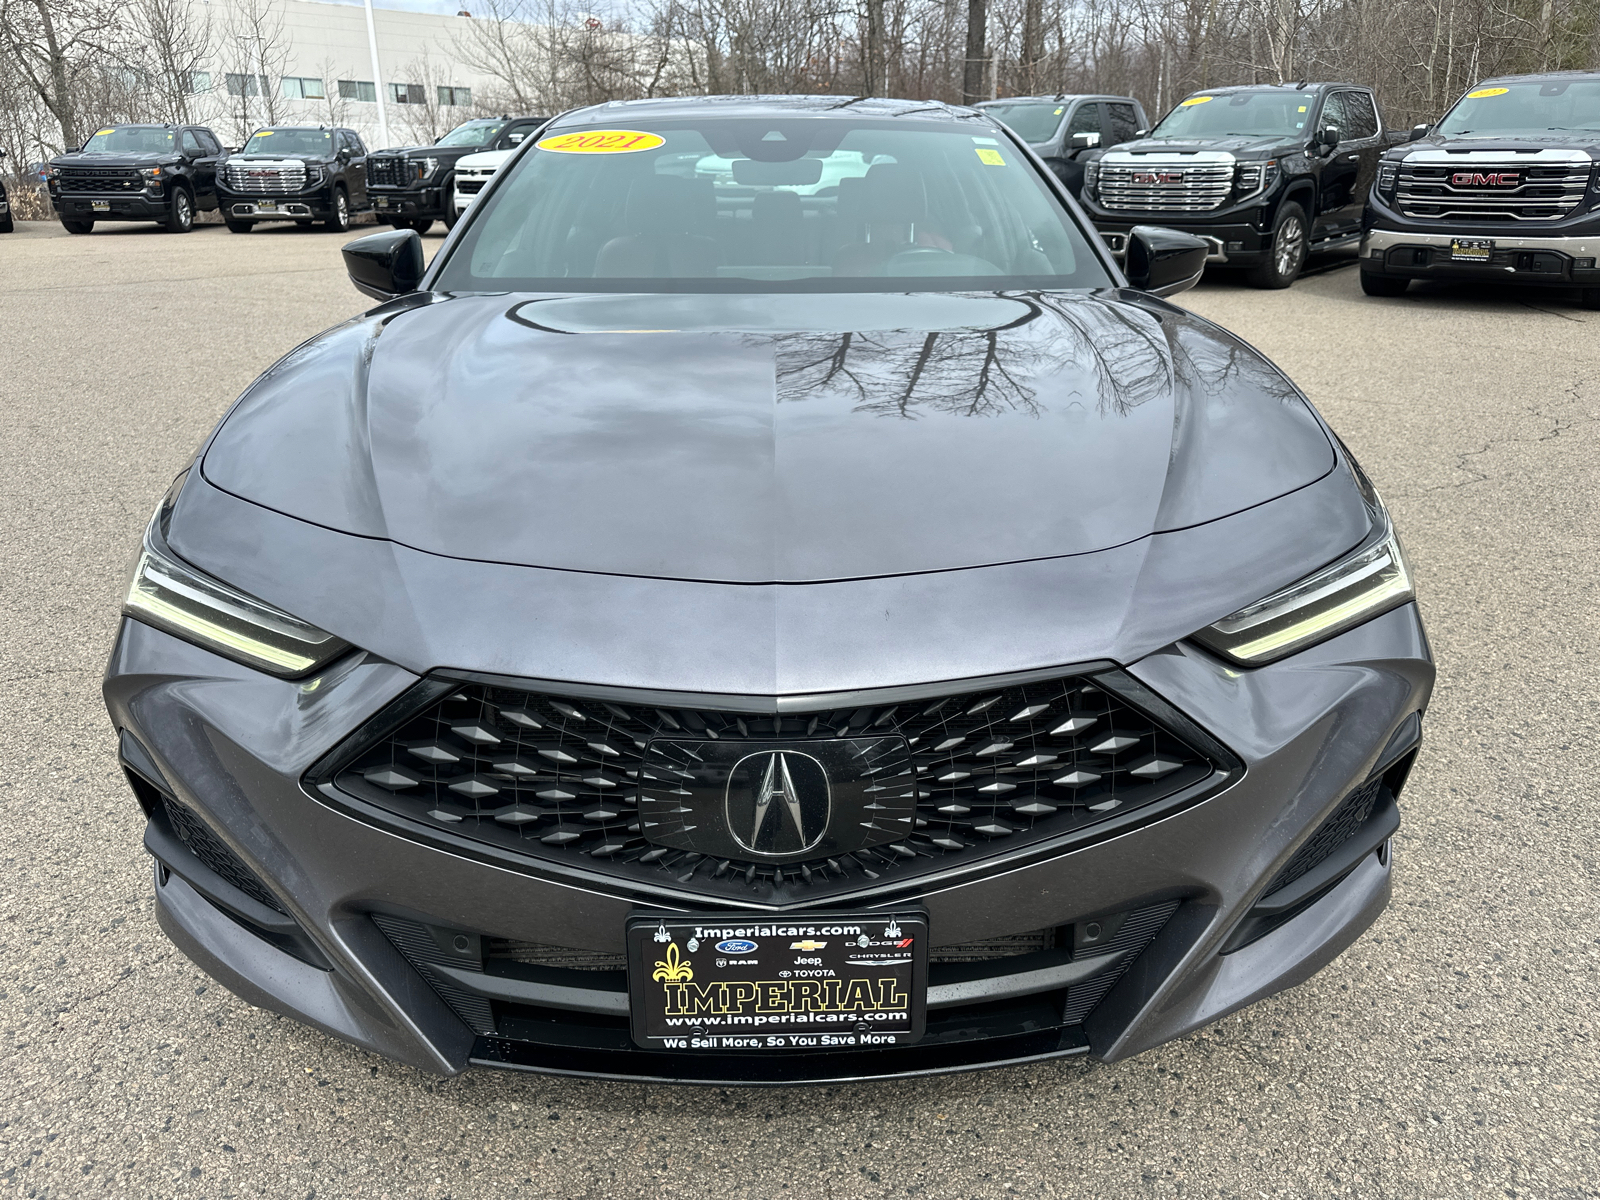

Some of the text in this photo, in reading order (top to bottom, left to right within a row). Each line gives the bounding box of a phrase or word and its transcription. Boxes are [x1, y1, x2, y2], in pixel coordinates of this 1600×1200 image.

[554, 135, 646, 149] 2021
[62, 169, 134, 177] CHEVROLET
[1133, 173, 1182, 183] GMC
[1452, 173, 1519, 185] GMC
[695, 924, 861, 940] Imperialcars.com
[724, 942, 749, 951] Ford
[794, 956, 822, 966] Jeep
[793, 969, 836, 977] TOYOTA
[664, 978, 908, 1015] IMPERIAL
[665, 1011, 908, 1026] www.imperialcars.com
[663, 1033, 896, 1049] We Sell More, So You Save More
